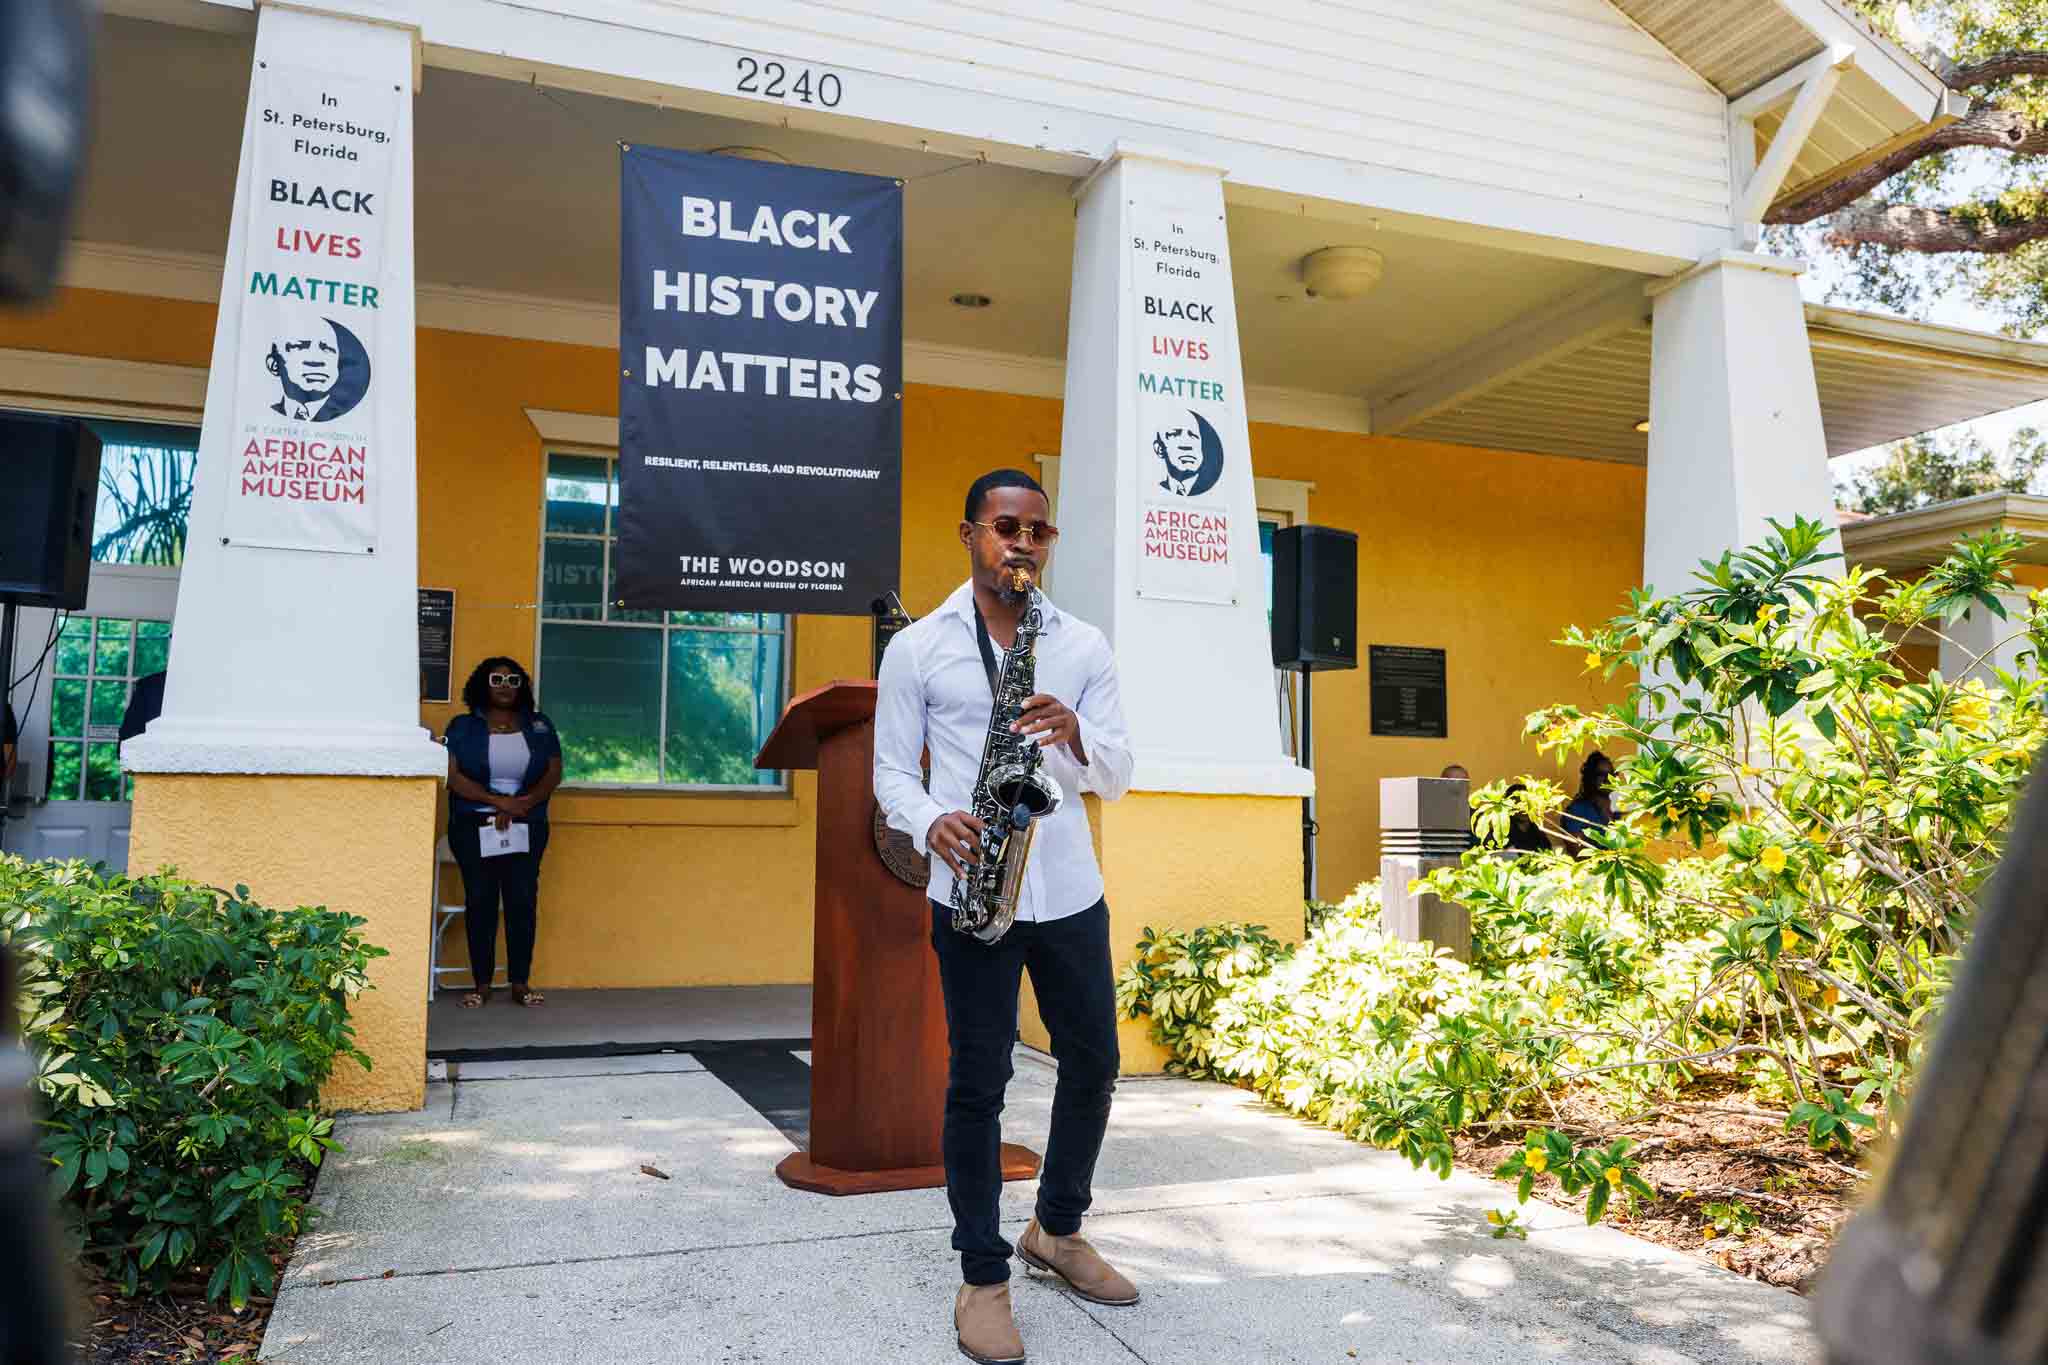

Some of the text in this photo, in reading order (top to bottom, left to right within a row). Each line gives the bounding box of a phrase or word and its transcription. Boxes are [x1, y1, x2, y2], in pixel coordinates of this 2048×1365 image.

[736, 57, 842, 107] 2240
[321, 92, 338, 107] In
[263, 109, 391, 144] St. Petersburg,
[294, 139, 358, 162] Florida
[270, 179, 375, 215] BLACK
[681, 196, 852, 254] BLACK
[1172, 223, 1184, 235] In
[277, 227, 361, 259] LIVES
[1134, 237, 1220, 265] St. Petersburg,
[1156, 261, 1201, 279] Florida
[250, 271, 379, 309] MATTER
[652, 269, 879, 328] HISTORY
[1144, 296, 1215, 324] BLACK
[1152, 335, 1210, 361] LIVES
[644, 346, 883, 403] MATTERS
[1138, 371, 1225, 402] MATTER
[243, 435, 366, 465] AFRICAN
[242, 458, 364, 483] AMERICAN
[644, 455, 880, 480] RESILIENT, RELENTLESS, AND REVOLUTIONARY
[241, 477, 364, 504] MUSEUM
[1144, 510, 1227, 532] AFRICAN
[1144, 527, 1227, 546] AMERICAN
[679, 556, 845, 578] THE WOODSON
[1145, 543, 1228, 565] MUSEUM
[680, 577, 843, 591] AFRICAN AMERICAN MUSEUM OF FLORIDA
